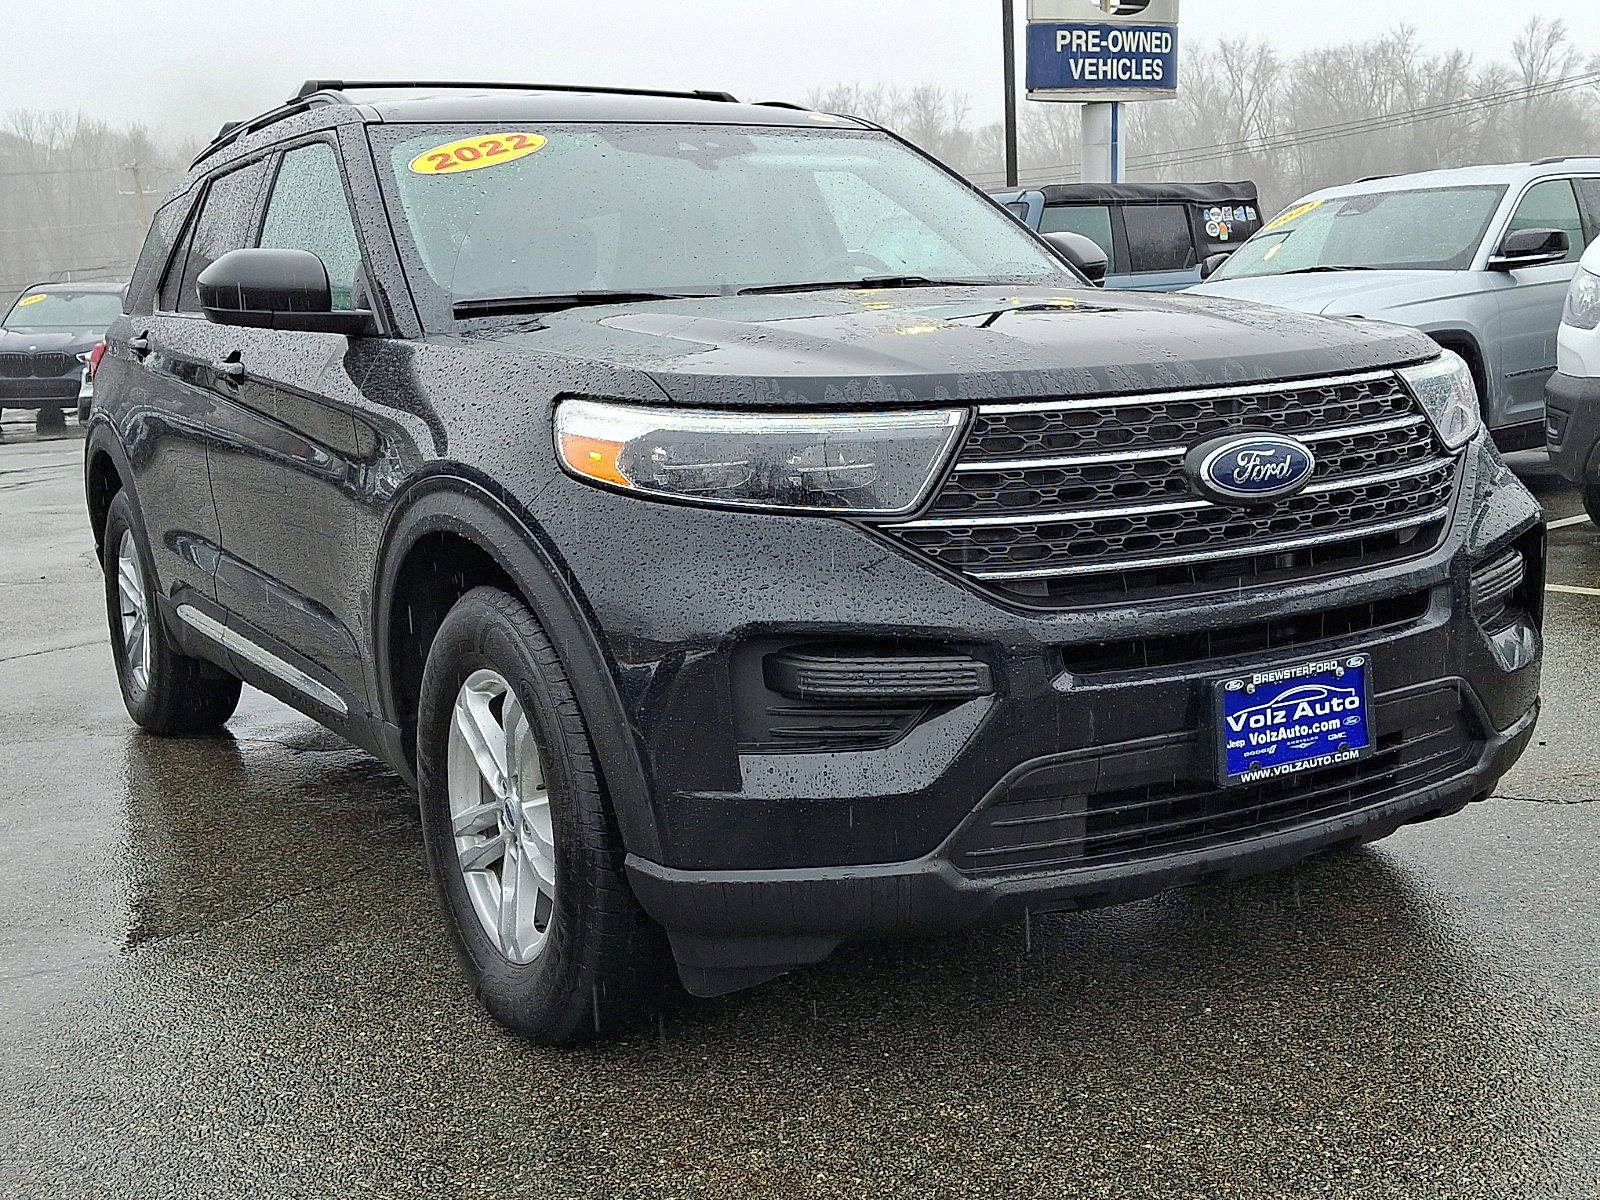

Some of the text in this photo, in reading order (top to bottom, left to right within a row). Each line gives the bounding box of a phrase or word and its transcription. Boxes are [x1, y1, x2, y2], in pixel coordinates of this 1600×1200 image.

[1056, 30, 1172, 53] PRE-OWNED
[1069, 58, 1163, 80] VEHICLES
[427, 134, 537, 171] 2022
[1233, 448, 1292, 484] Ford
[1226, 696, 1360, 732] Volz Auto
[1226, 739, 1246, 749] Jeep
[1249, 718, 1340, 746] VolzAuto.com
[1327, 731, 1347, 741] GMC
[1241, 750, 1360, 783] WWW.VOLZAUTO.COM
